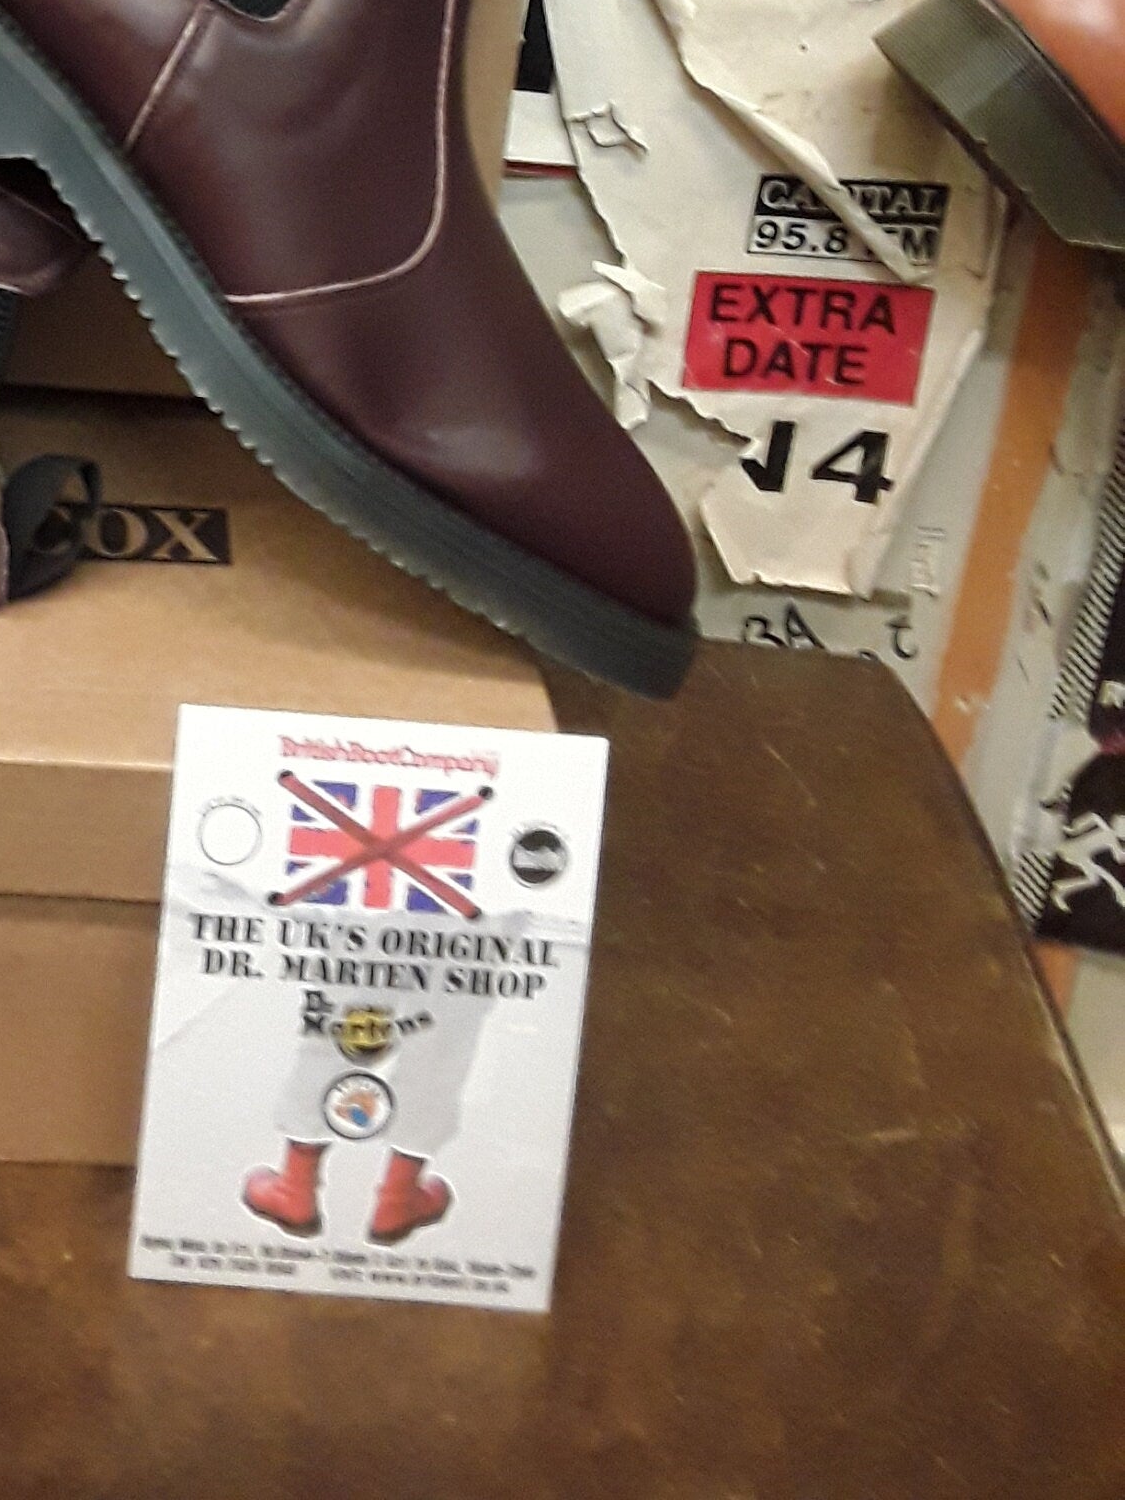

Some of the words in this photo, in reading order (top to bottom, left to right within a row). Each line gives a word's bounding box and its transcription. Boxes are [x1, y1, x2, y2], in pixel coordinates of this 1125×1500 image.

[755, 220, 849, 253] 95.8
[710, 283, 898, 335] EXTRA
[722, 337, 870, 386] DATE
[192, 912, 265, 945] THE
[276, 918, 368, 953] UK'S
[380, 927, 561, 968] ORIGINAL
[201, 948, 264, 979] DR.
[278, 954, 434, 991] MARTEN
[444, 968, 548, 1001] SHOP
